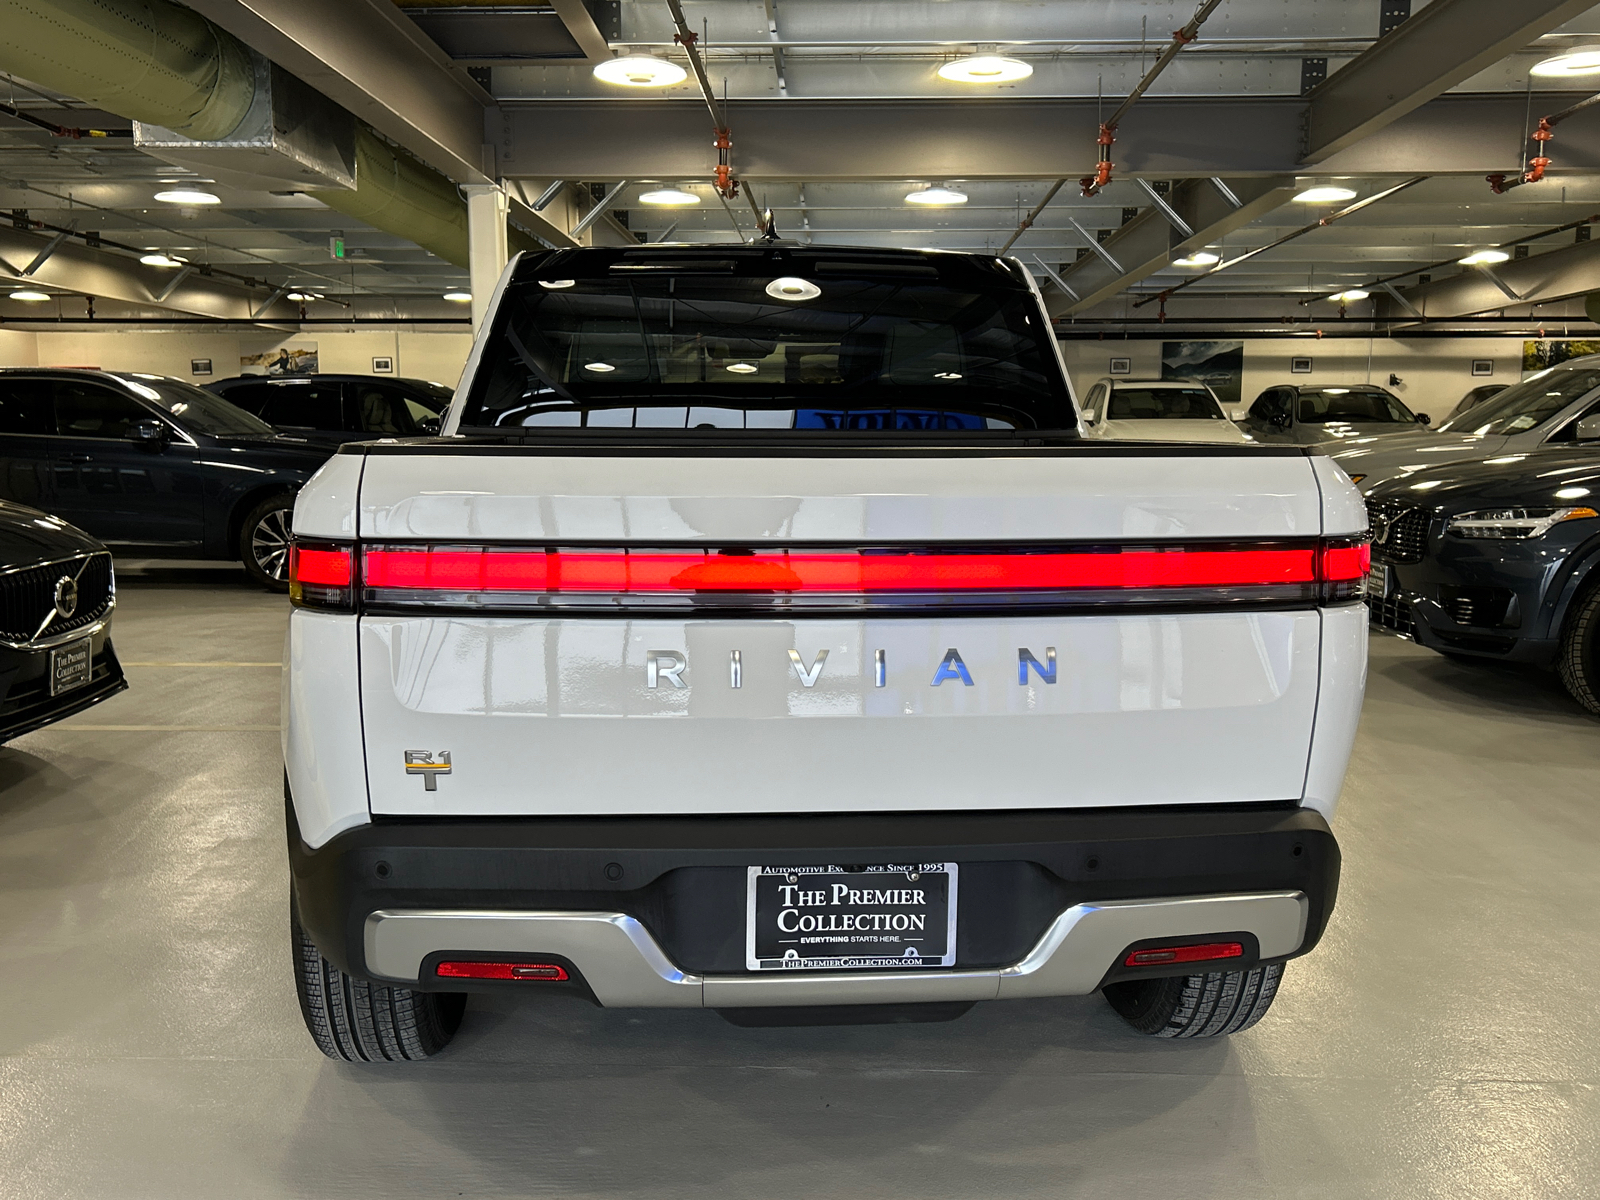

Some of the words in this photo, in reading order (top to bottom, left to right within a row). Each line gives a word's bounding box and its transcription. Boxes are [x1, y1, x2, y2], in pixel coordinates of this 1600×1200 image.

[646, 646, 1057, 688] RIVIAN
[763, 865, 825, 874] AUTOMOTIVE
[887, 863, 914, 872] SINCE
[918, 863, 944, 872] 1995
[778, 884, 827, 907] THE
[831, 883, 926, 906] PREMIER
[777, 908, 926, 933] COLLECTION
[800, 936, 849, 944] EVERYTHING
[850, 935, 879, 943] STARTS
[879, 935, 902, 943] HERE.
